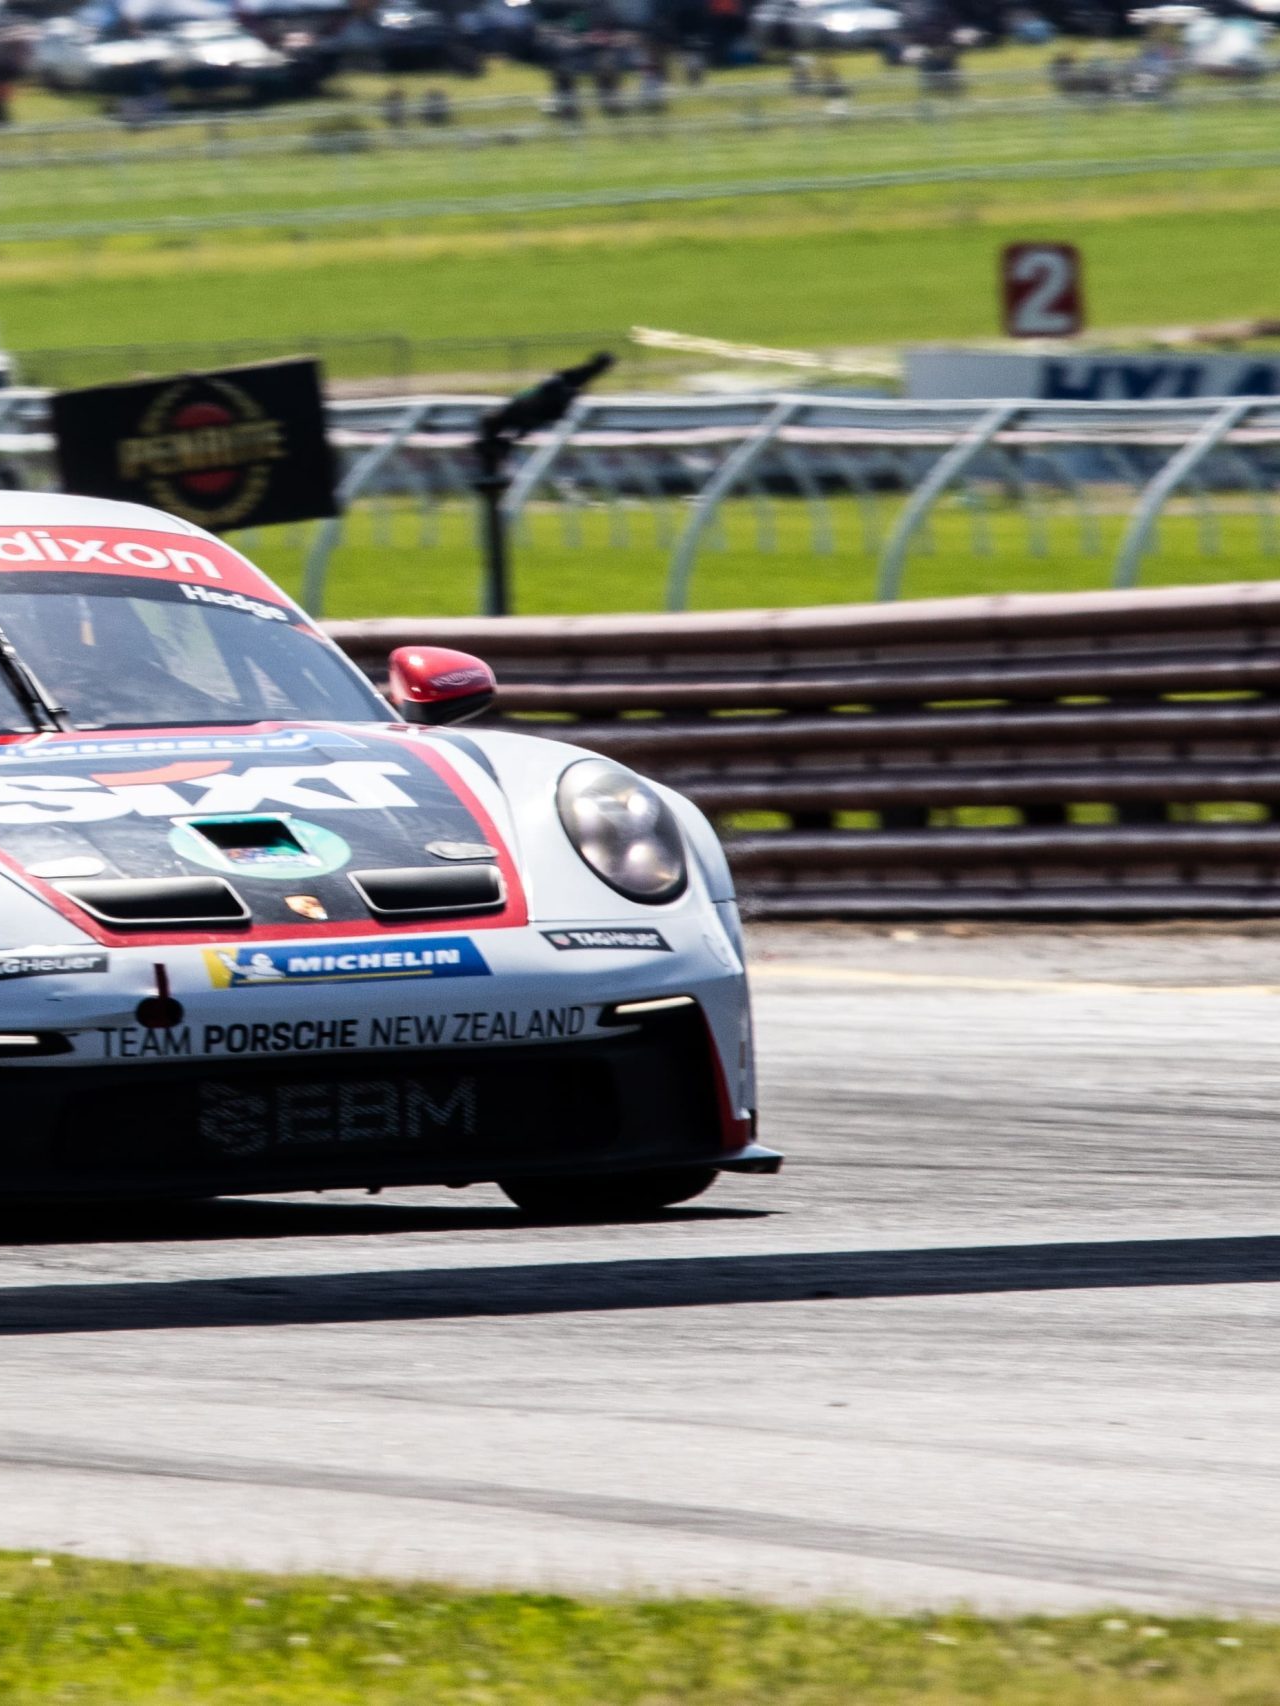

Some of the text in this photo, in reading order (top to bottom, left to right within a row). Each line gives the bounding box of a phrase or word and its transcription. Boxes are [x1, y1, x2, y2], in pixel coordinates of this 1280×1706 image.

[1012, 250, 1073, 333] 2
[179, 583, 289, 622] Hedge
[26, 733, 310, 758] MICHELIN
[288, 949, 461, 974] MICHELIN
[97, 1006, 586, 1057] TEAM PORSCHE NEW ZEALAND
